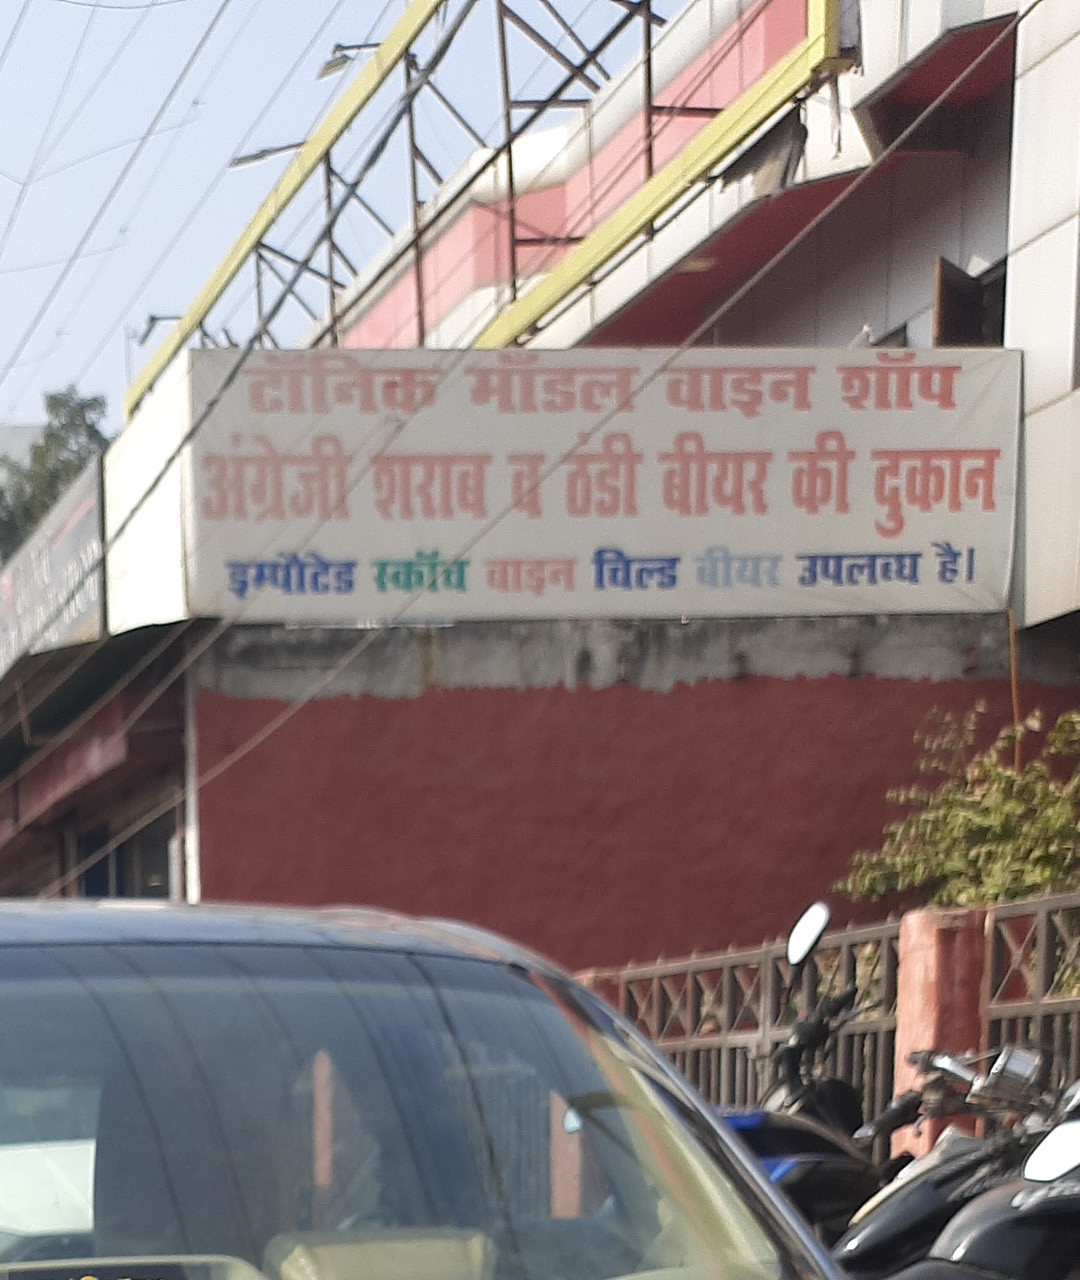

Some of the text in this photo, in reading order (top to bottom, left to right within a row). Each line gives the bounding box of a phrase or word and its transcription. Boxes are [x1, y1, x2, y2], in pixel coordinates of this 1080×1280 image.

[242, 352, 962, 418] टॉनिक मॉडल वाइन शॉप
[201, 431, 1002, 539] अंग्रेजी शराब व ठंडी बीयर की दुकान
[485, 556, 576, 597] वाइन
[693, 546, 782, 590] बीयर
